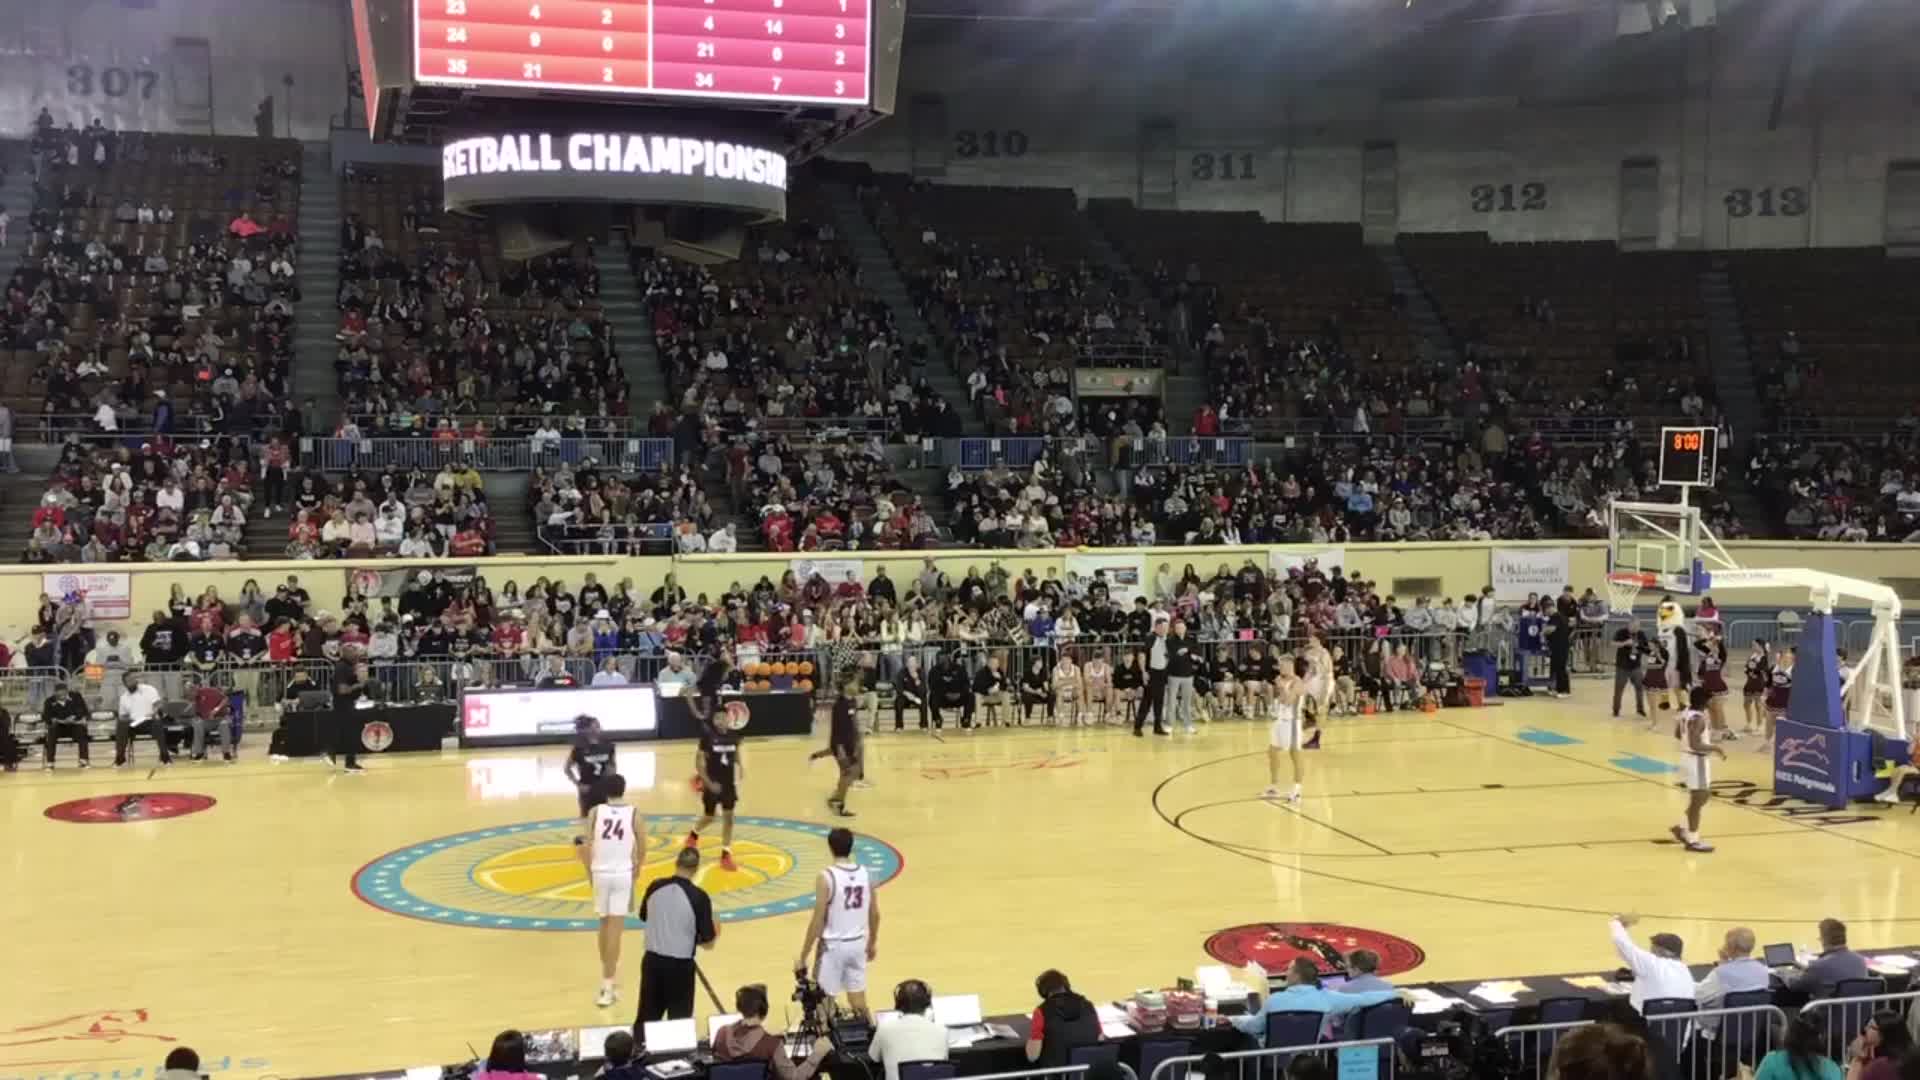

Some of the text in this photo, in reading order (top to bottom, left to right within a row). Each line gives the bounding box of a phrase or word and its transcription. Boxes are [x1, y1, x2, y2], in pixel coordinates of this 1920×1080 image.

[529, 5, 541, 20] 4
[601, 9, 613, 24] 2
[446, 27, 467, 43] 24
[703, 16, 845, 39] 4 14 3
[697, 42, 715, 57] 21
[835, 50, 845, 65] 2
[66, 64, 160, 100] 307
[523, 63, 542, 79] 21
[602, 67, 613, 82] 2
[695, 72, 845, 95] 34 7 3
[955, 130, 1029, 158] 310
[1190, 152, 1257, 180] 311
[1470, 182, 1547, 213] 312
[1725, 186, 1809, 217] 313
[602, 818, 625, 841] 24
[843, 885, 865, 910] 23
